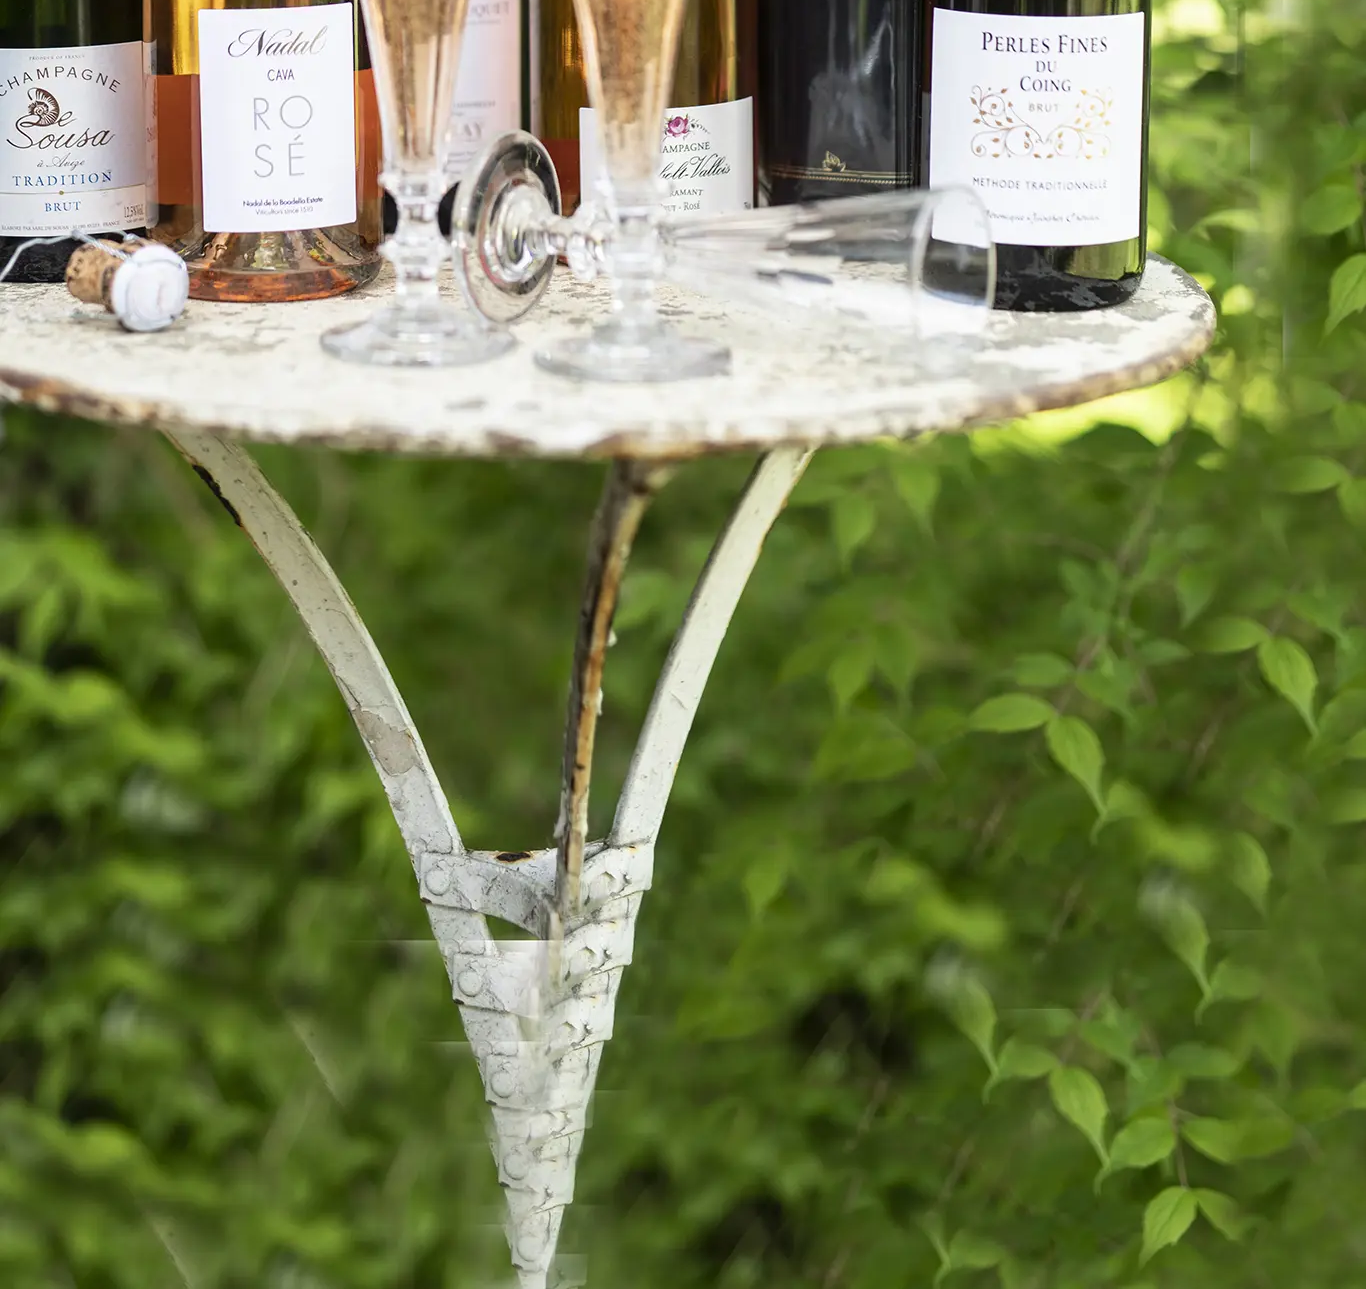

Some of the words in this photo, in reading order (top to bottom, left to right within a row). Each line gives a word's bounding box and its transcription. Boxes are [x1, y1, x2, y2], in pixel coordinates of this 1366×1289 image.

[227, 25, 328, 58] Nadal
[981, 31, 1050, 54] PERLES
[1058, 34, 1108, 54] FINES
[1035, 60, 1057, 73] DU
[0, 65, 121, 97] CHAMPAGNE
[267, 69, 295, 82] CAVA
[1019, 75, 1072, 93] COING
[253, 95, 313, 131] RO
[1028, 102, 1060, 113] BRUT
[6, 114, 115, 150] Sousa
[254, 134, 305, 178] SÉ
[660, 141, 711, 154] AMPAGNE
[659, 153, 731, 180] bolt-Vallois
[12, 170, 113, 187] TRADITION
[1025, 180, 1108, 192] TRADITIONNELLE
[243, 199, 263, 207] Nadal
[264, 198, 272, 206] de
[306, 196, 323, 204] Estate
[669, 189, 704, 197] RAMANT
[44, 200, 82, 212] BRUT
